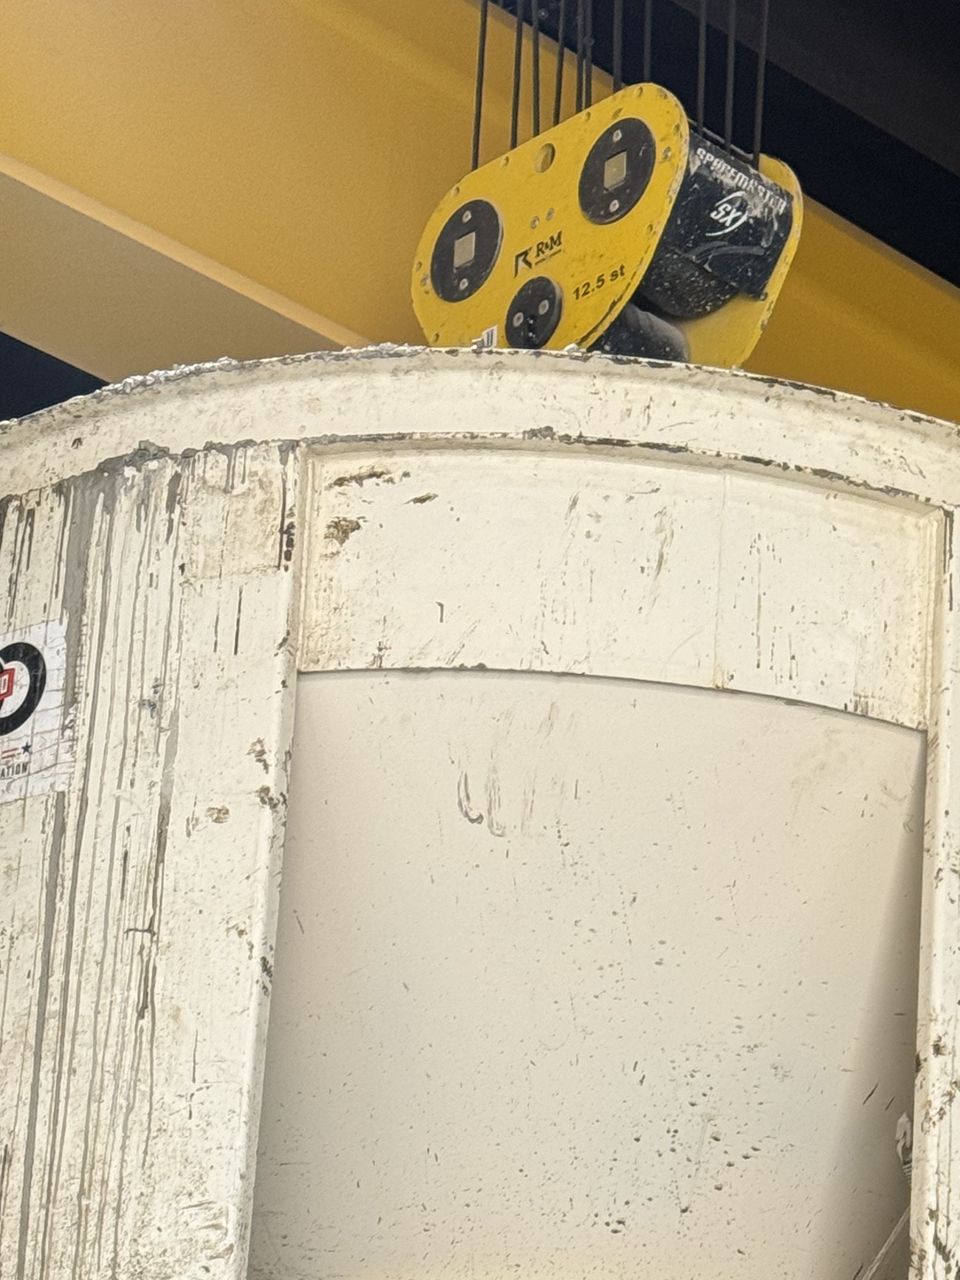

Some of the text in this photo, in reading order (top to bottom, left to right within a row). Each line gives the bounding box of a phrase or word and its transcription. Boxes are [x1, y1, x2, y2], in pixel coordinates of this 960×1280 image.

[710, 203, 743, 227] SX
[573, 264, 626, 300] 12.5 st
